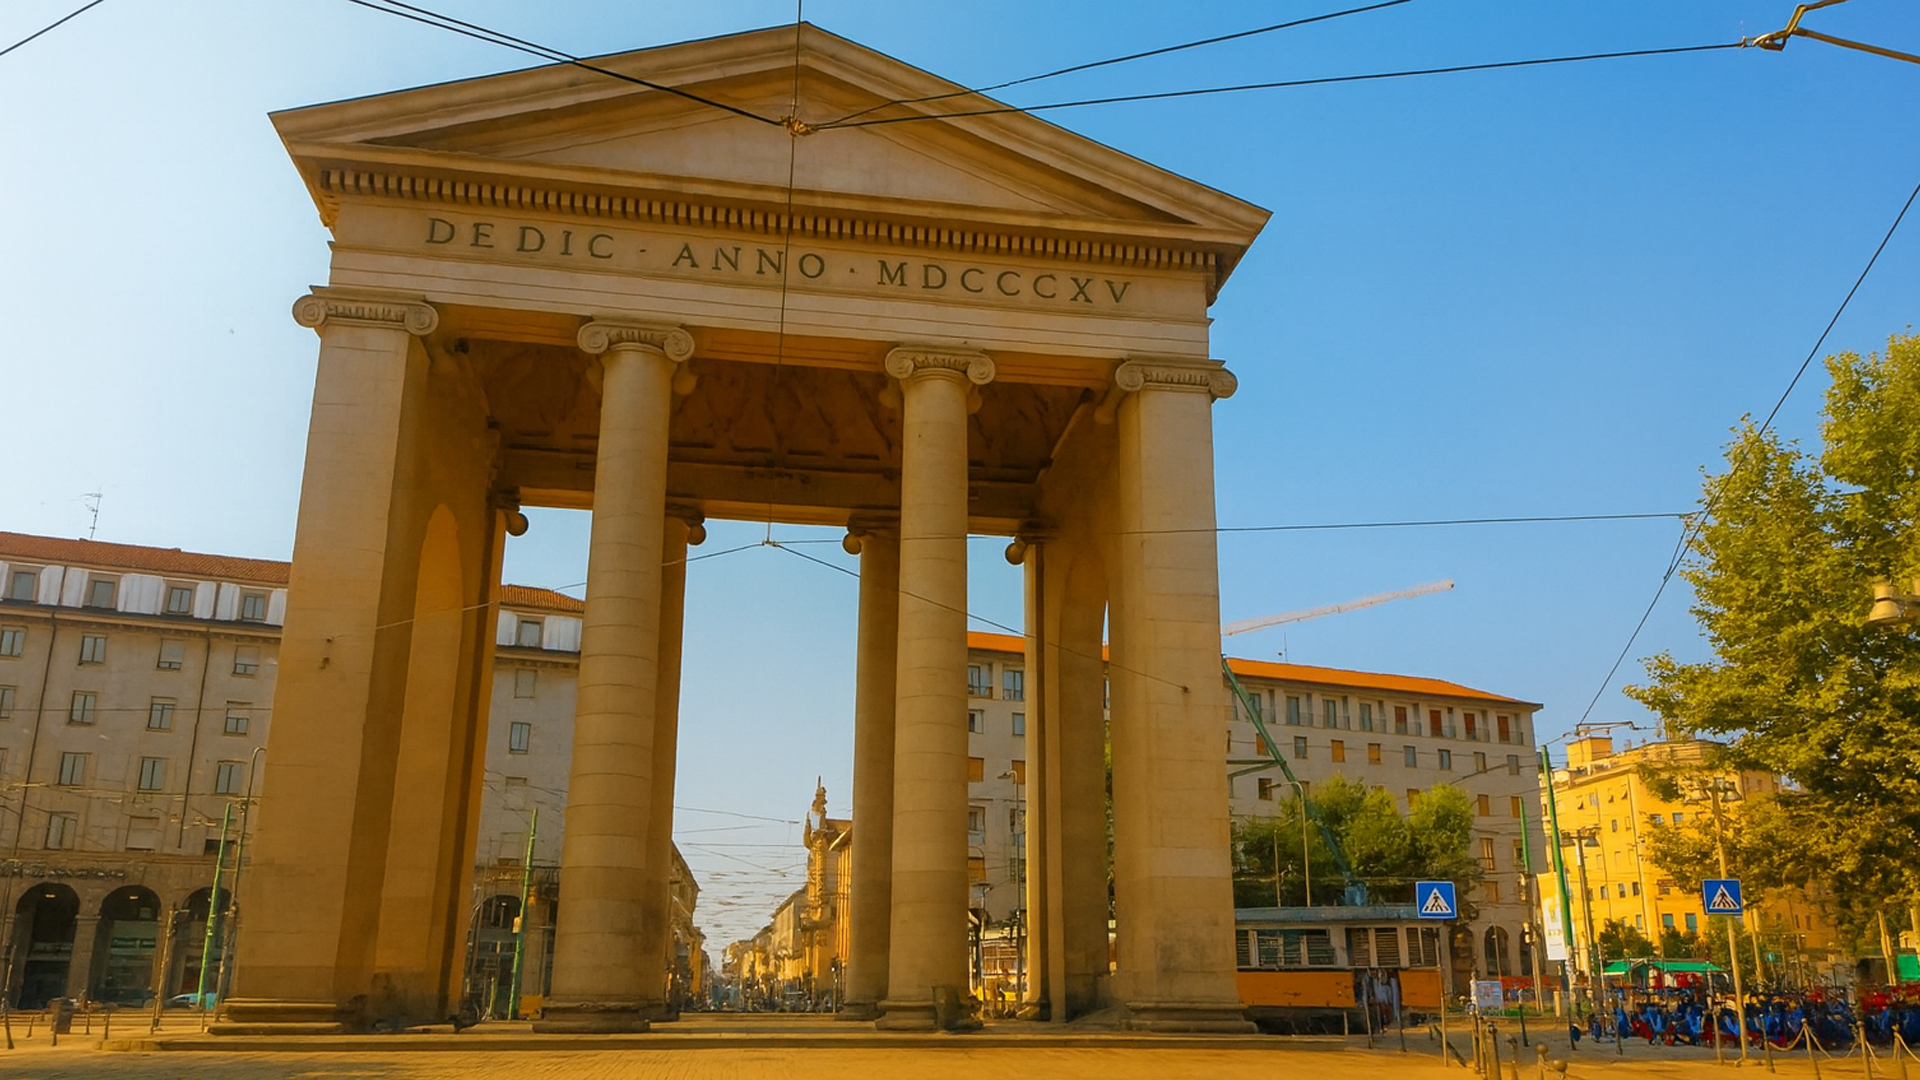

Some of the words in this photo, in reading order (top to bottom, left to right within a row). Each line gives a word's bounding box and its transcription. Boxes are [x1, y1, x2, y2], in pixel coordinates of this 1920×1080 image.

[425, 217, 614, 259] DEDIC
[671, 243, 826, 279] ANNO
[877, 260, 1131, 304] MDCCCXV
